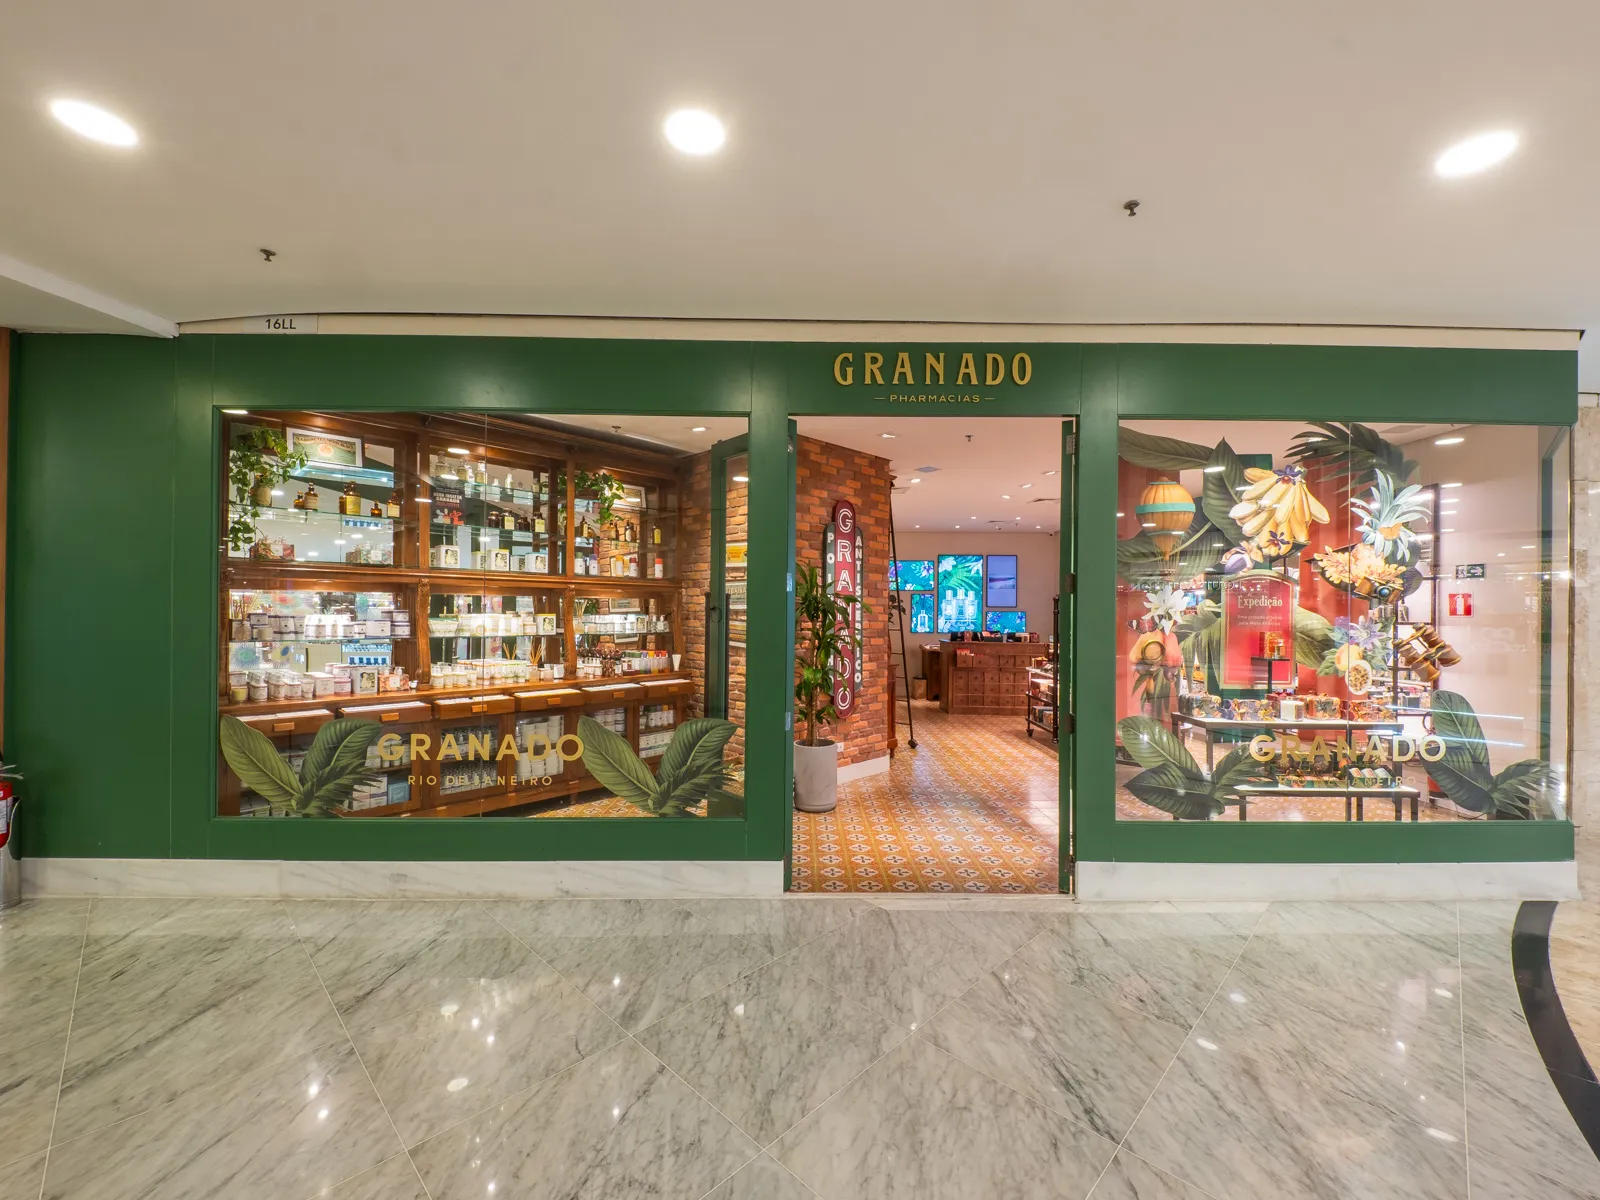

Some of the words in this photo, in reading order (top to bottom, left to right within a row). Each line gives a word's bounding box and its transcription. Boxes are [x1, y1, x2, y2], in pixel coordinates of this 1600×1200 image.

[265, 318, 297, 330] 16LL
[833, 351, 1033, 386] GRANADO
[826, 532, 836, 684] POLHO
[1237, 594, 1283, 609] Expedição
[377, 733, 585, 762] GRANADO
[1248, 734, 1447, 763] GRANADO
[408, 775, 438, 786] RIO
[445, 775, 466, 786] DE
[473, 775, 553, 786] JANEIRO
[1278, 776, 1307, 787] RIO
